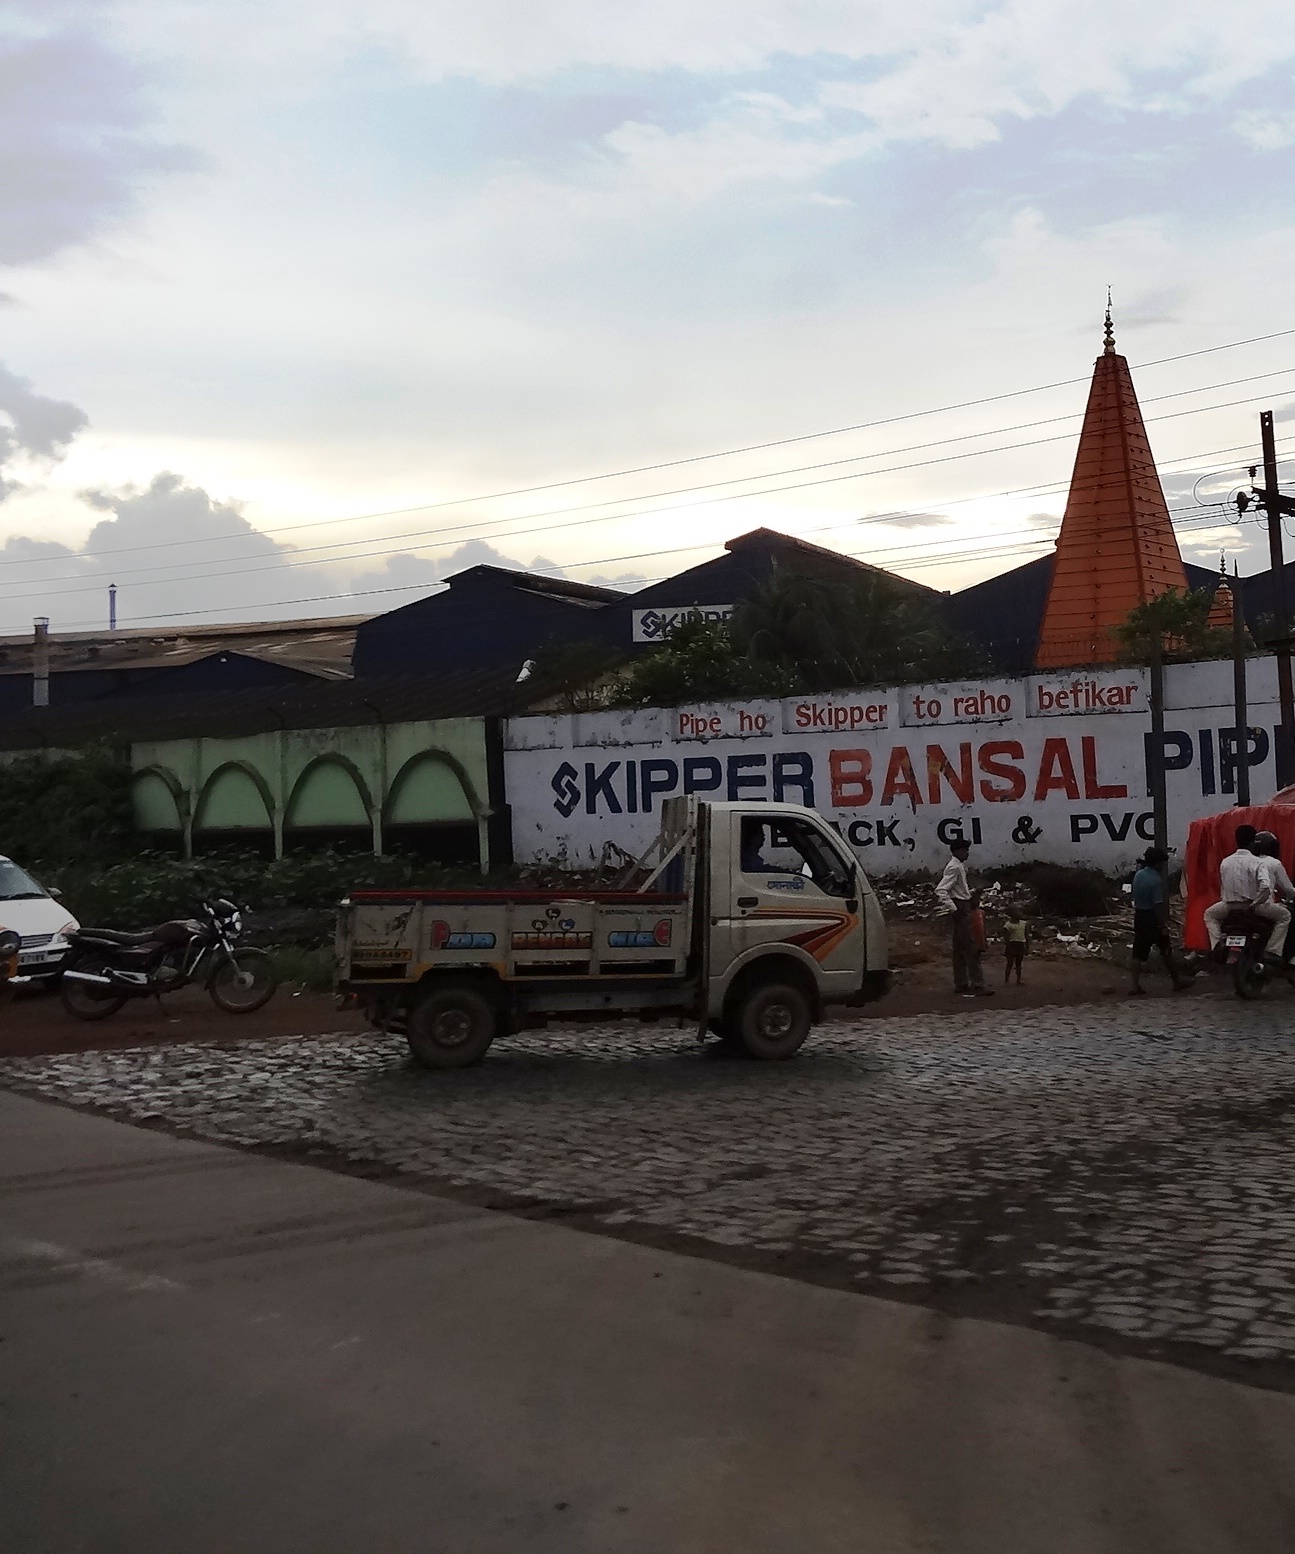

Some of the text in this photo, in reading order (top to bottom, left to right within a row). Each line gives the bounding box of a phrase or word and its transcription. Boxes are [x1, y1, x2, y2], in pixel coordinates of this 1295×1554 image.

[679, 681, 1139, 737] Pipe ho Skipper to raho befikar
[551, 752, 815, 817] SKIPPER
[829, 736, 1127, 812] BANSAL
[937, 817, 982, 846] GI
[1012, 815, 1043, 844] &
[1070, 812, 1155, 842] PVC
